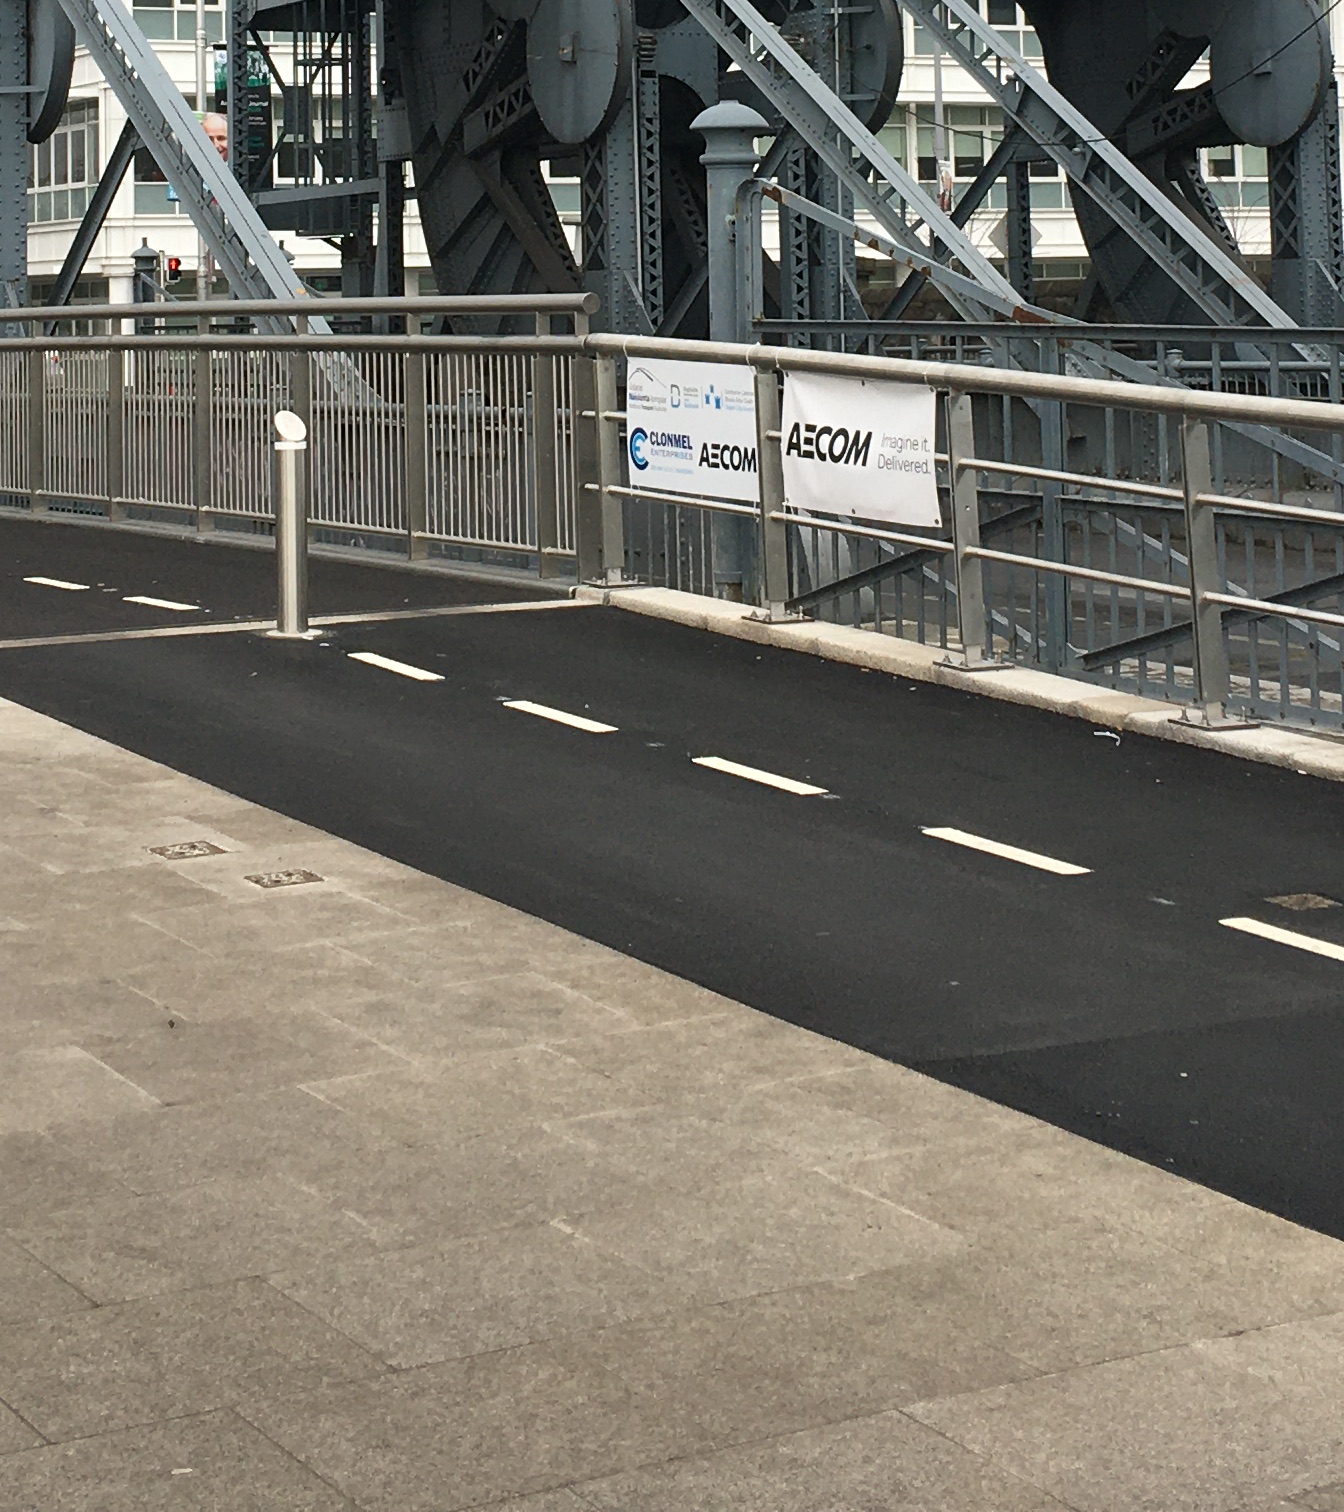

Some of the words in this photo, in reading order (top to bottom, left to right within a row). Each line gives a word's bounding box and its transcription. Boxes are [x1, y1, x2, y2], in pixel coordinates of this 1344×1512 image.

[649, 431, 693, 450] CLONMEL
[698, 442, 758, 473] AECOM
[785, 421, 873, 467] AECOM
[880, 432, 919, 454] Imagine
[920, 436, 931, 453] it.
[877, 453, 931, 475] Delivered.
